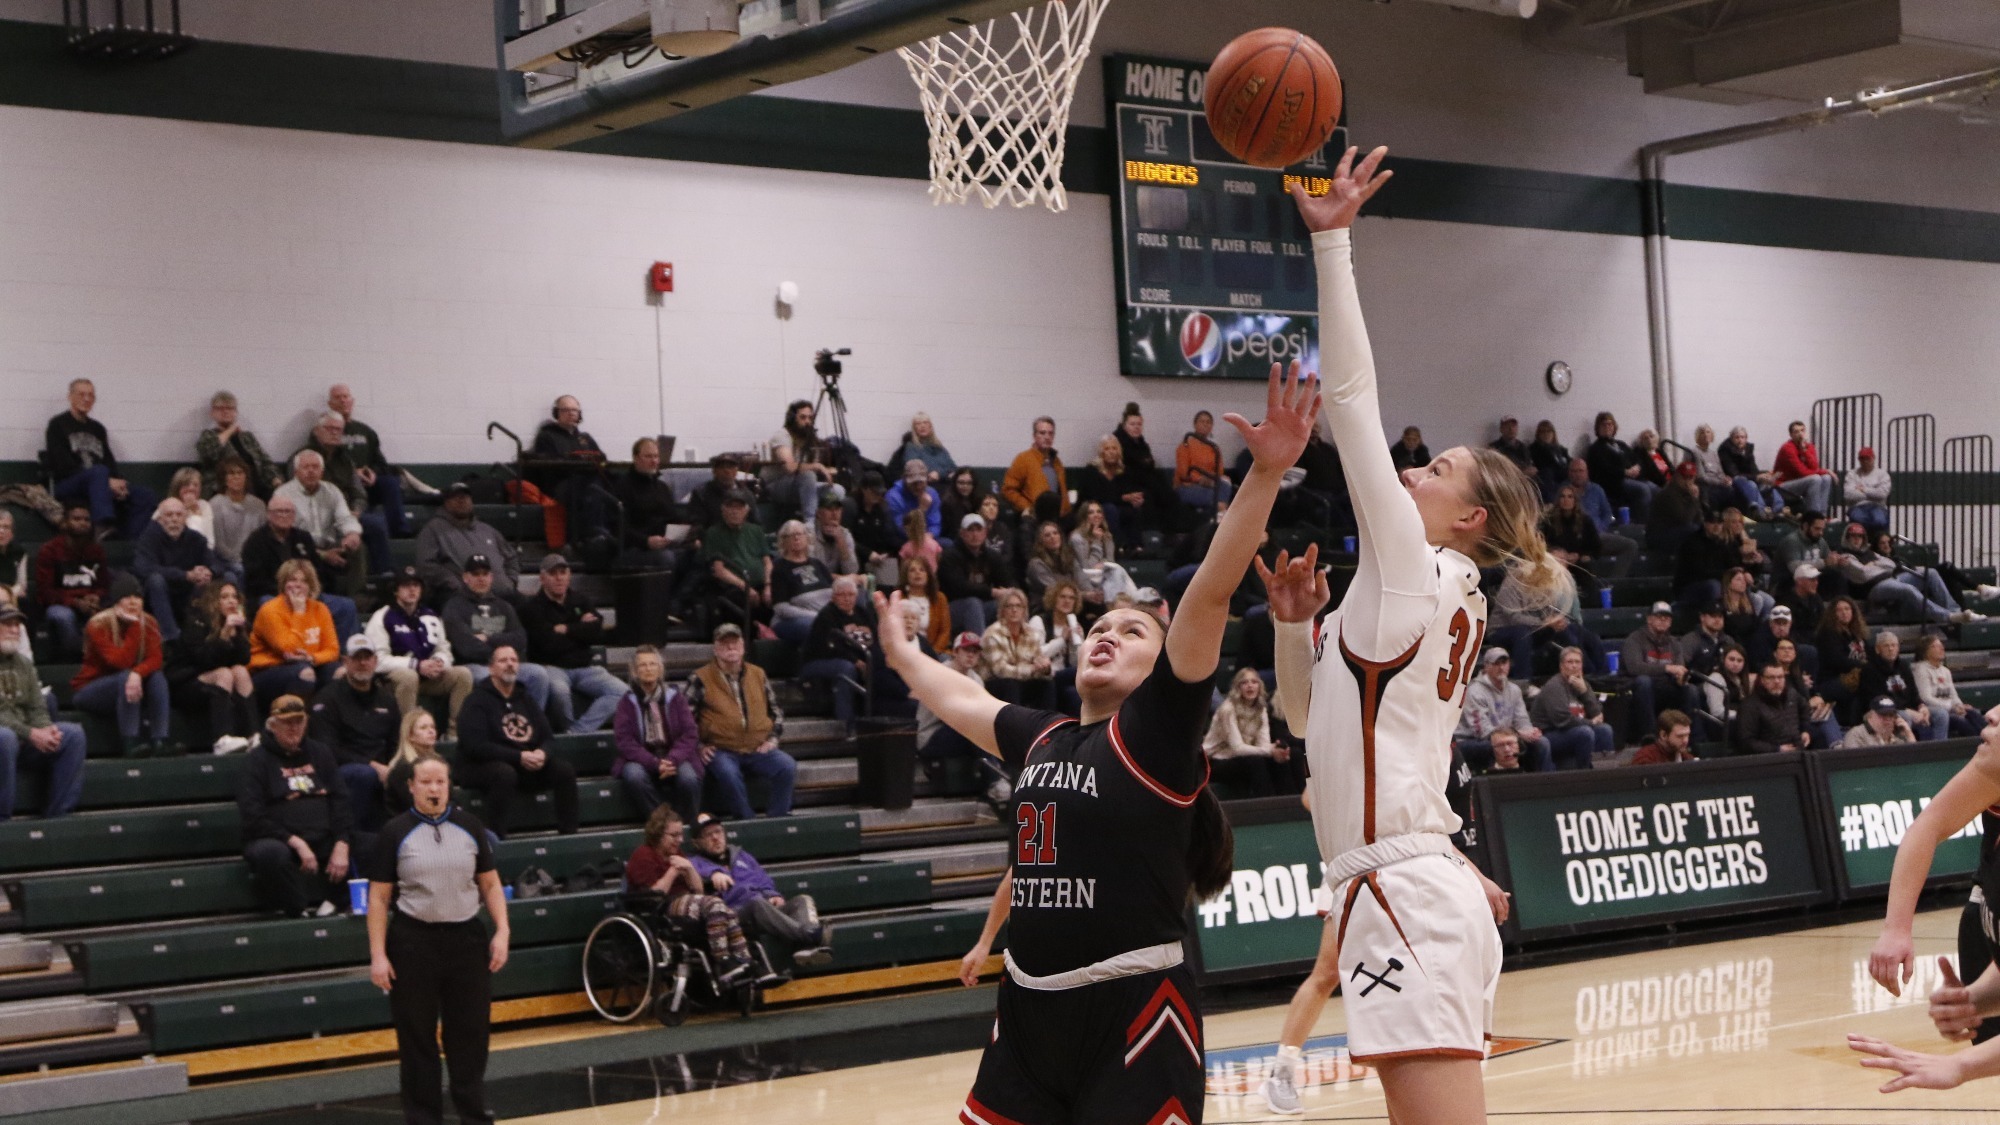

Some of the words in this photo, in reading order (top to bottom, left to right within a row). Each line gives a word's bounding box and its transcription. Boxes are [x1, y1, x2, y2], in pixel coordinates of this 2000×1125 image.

[1125, 62, 1184, 102] HOME
[1125, 160, 1199, 186] DIGGERS
[1223, 180, 1257, 195] PERIOD
[1137, 232, 1169, 248] FOULS
[1211, 238, 1246, 253] PLAYER
[1251, 241, 1274, 255] FOUL
[1139, 287, 1171, 302] SCORE
[1229, 292, 1262, 307] MATCH
[1227, 327, 1308, 364] pepsi
[1014, 761, 1099, 799] ONTANA
[1016, 802, 1057, 865] 21
[1556, 806, 1649, 855] HOME
[1653, 802, 1690, 844] OF
[1696, 796, 1760, 840] THE
[1565, 840, 1768, 906] OREDIGGERS
[1010, 877, 1096, 909] ESTERN
